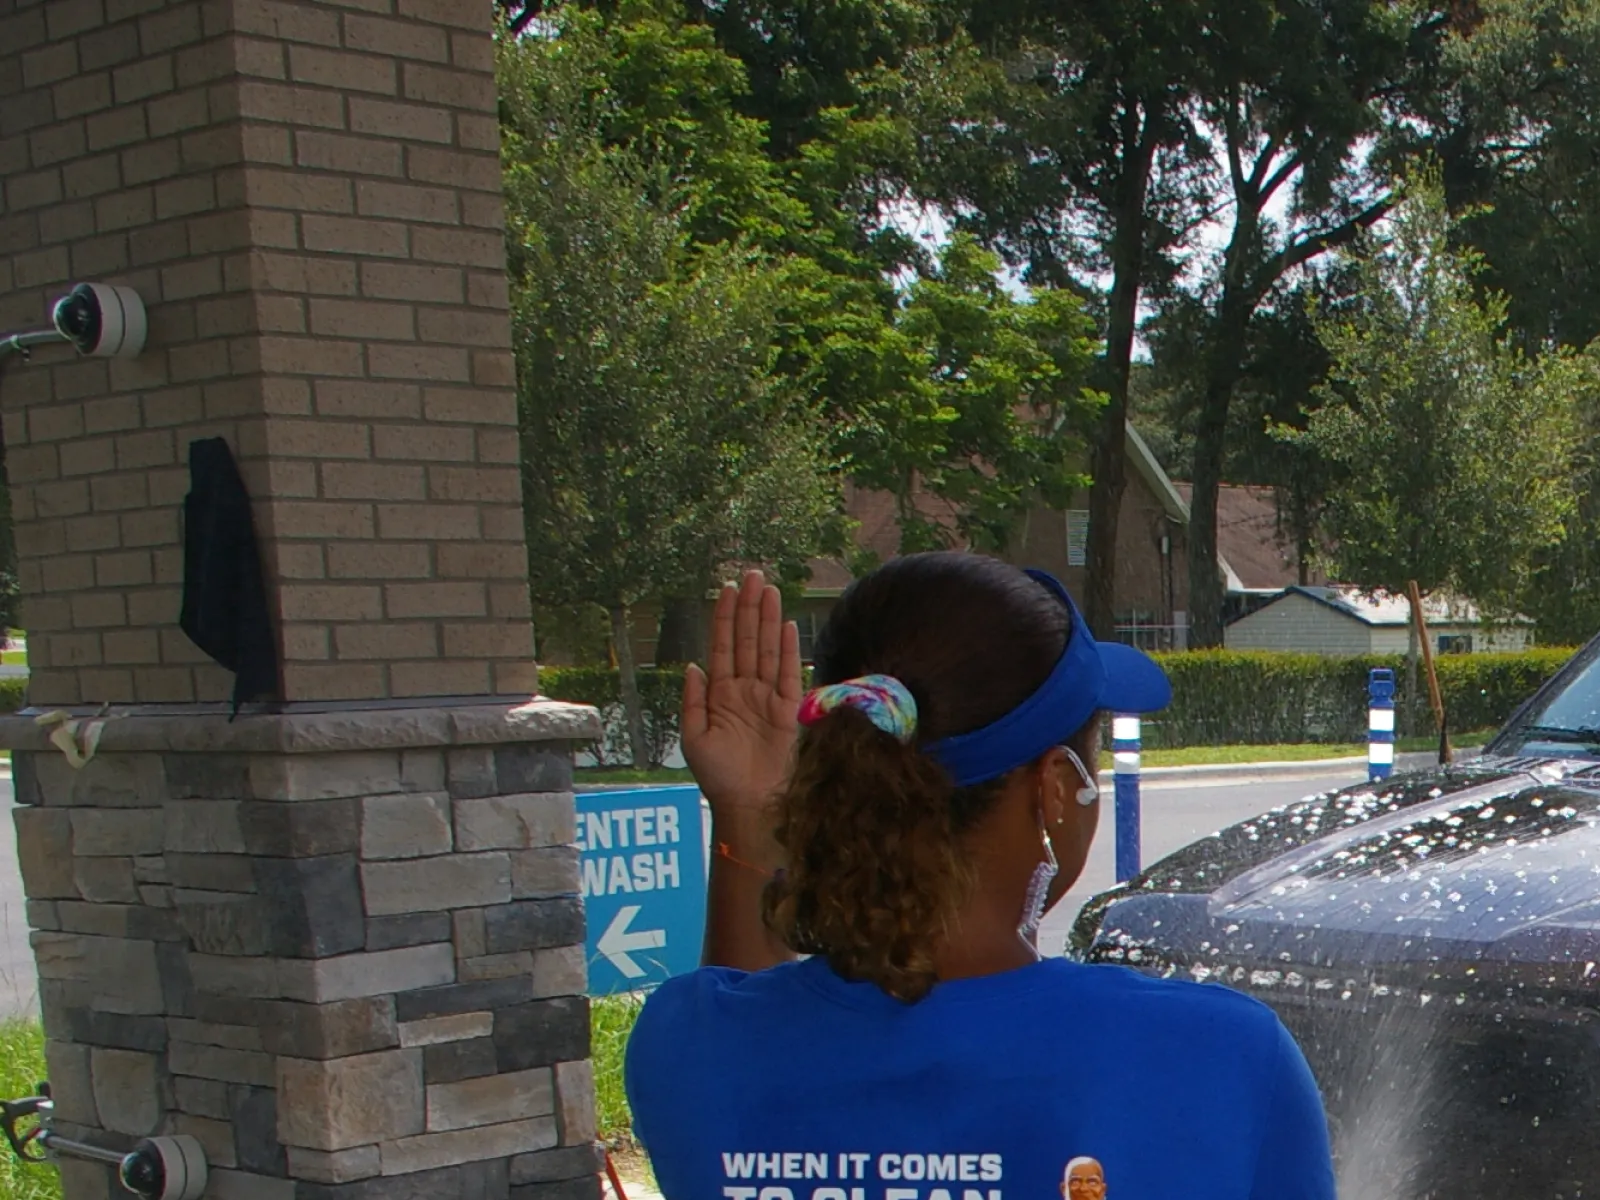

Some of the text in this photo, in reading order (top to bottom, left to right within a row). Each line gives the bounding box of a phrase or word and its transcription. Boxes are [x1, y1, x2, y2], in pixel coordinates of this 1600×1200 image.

[579, 850, 680, 898] WASH
[722, 1152, 1003, 1182] WHEN IT COMES
